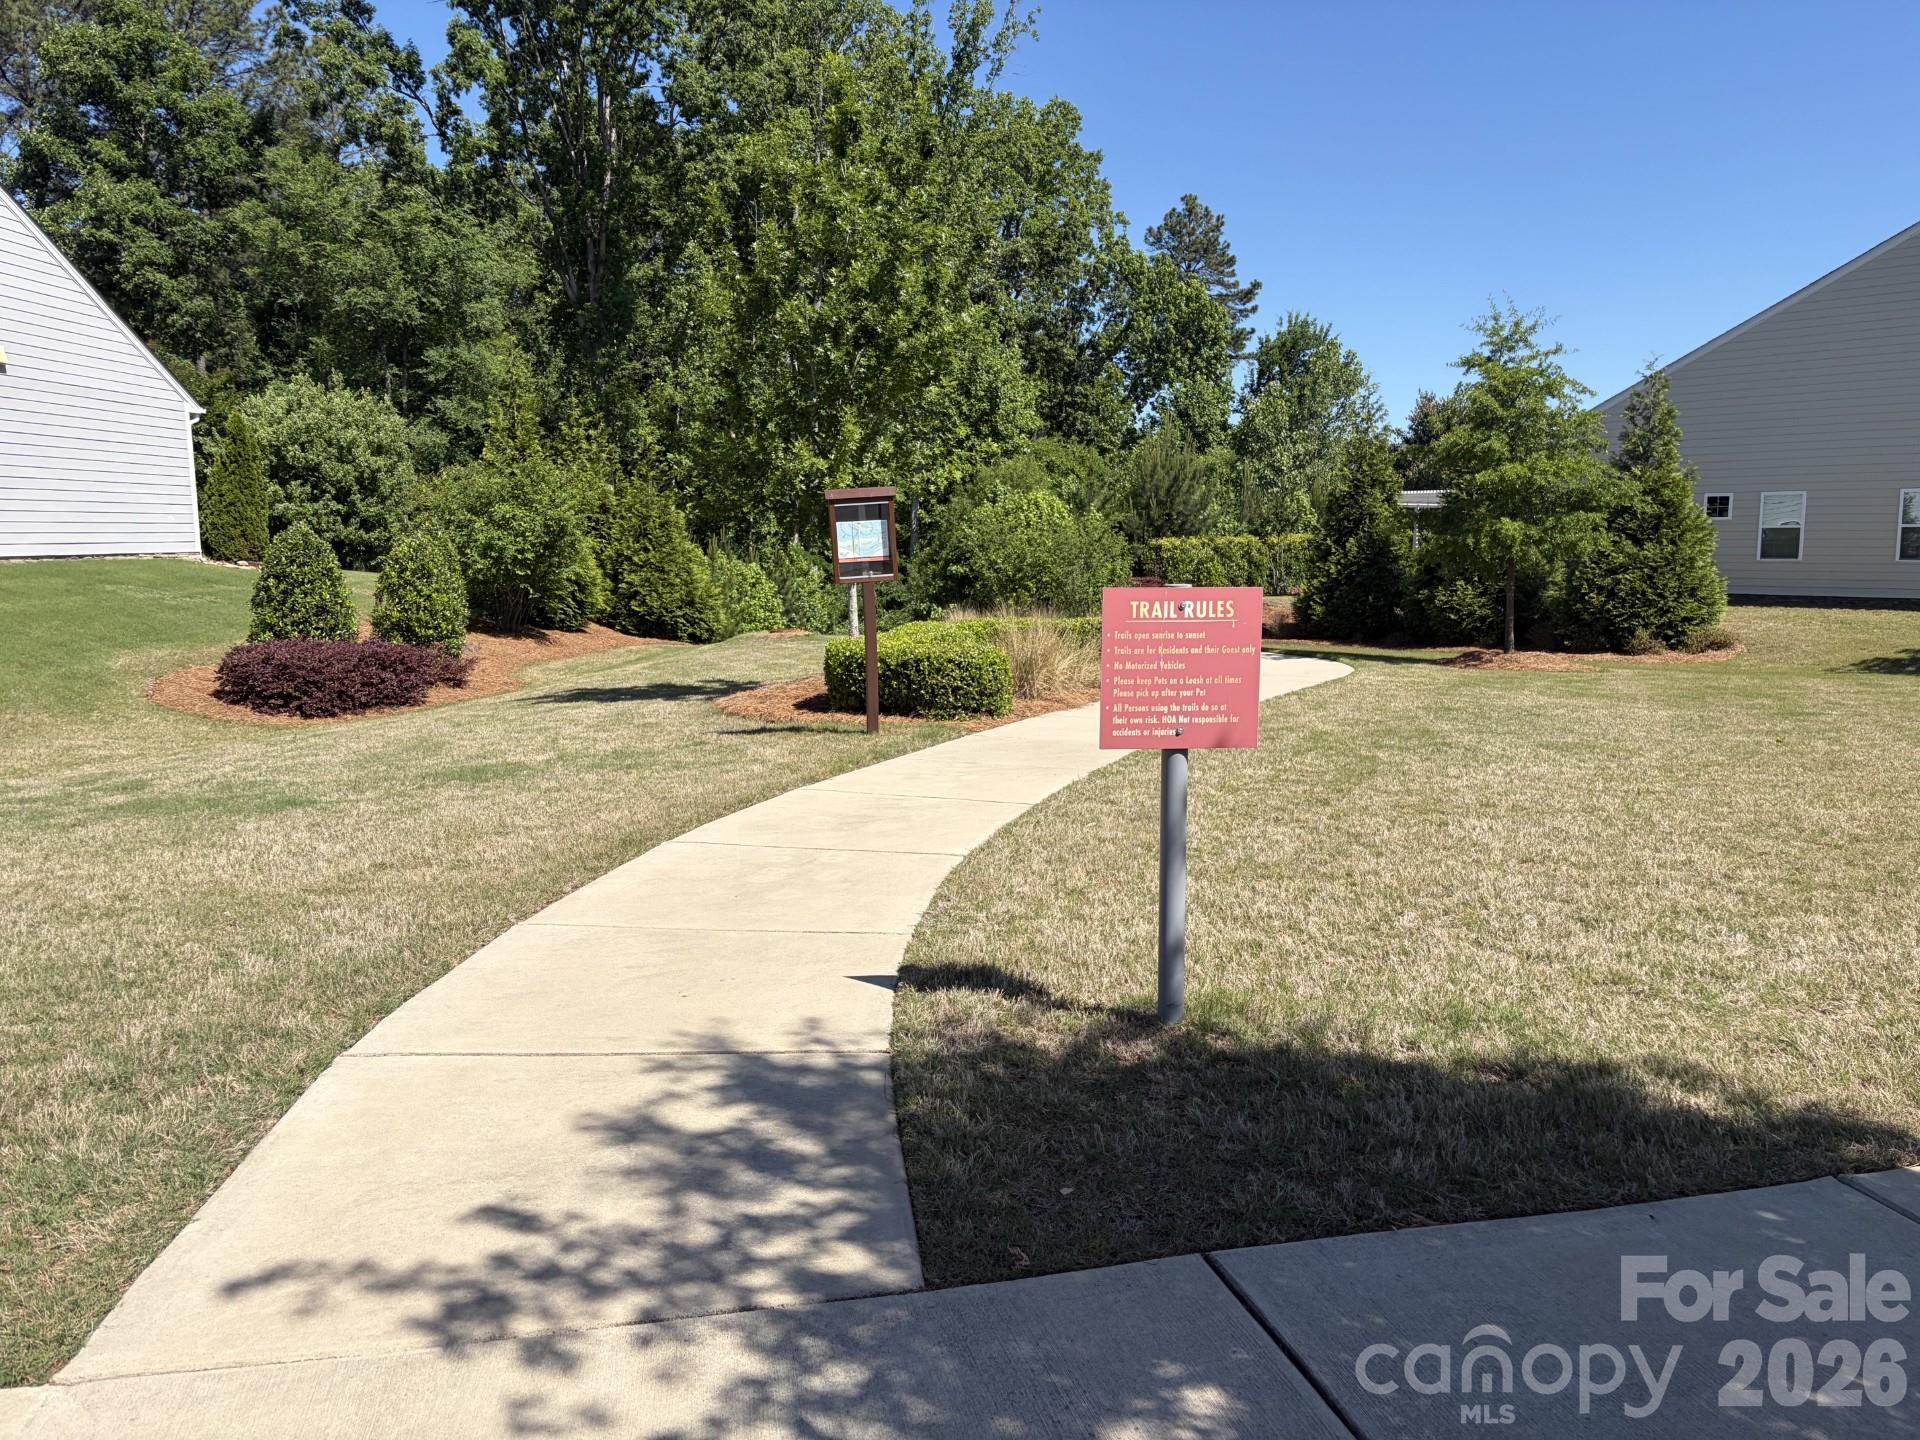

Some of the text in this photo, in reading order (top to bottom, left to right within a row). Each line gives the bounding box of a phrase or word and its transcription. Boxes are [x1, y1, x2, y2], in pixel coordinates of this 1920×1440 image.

[1130, 600, 1234, 618] TRAIL RULES
[1114, 630, 1206, 641] Trails open sunrise to sunset
[1114, 645, 1132, 654] Trails
[1146, 644, 1156, 654] for
[1158, 645, 1189, 654] Residents
[1190, 644, 1203, 654] and
[1204, 644, 1219, 654] their
[1222, 645, 1240, 654] Guest
[1241, 643, 1256, 656] only
[1114, 660, 1186, 670] No Motorized Vehicles
[1113, 676, 1134, 685] Please
[1137, 675, 1152, 686] keep
[1154, 676, 1167, 685] Pets
[1185, 675, 1204, 684] Leash
[1205, 676, 1212, 684] at
[1214, 675, 1223, 684] all
[1224, 675, 1242, 684] times
[1113, 687, 1206, 700] Please pick up after your Pet
[1113, 703, 1122, 712] All
[1124, 703, 1149, 712] Persons
[1151, 703, 1168, 713] using
[1170, 702, 1180, 711] the
[1182, 702, 1199, 712] trails
[1201, 702, 1209, 711] do
[1220, 703, 1227, 711] at
[1112, 715, 1127, 724] their
[1145, 715, 1160, 724] risk.
[1162, 715, 1176, 724] HOA
[1178, 714, 1190, 723] Not
[1192, 713, 1228, 725] responsible
[1230, 713, 1240, 723] for
[1112, 727, 1141, 736] accidents
